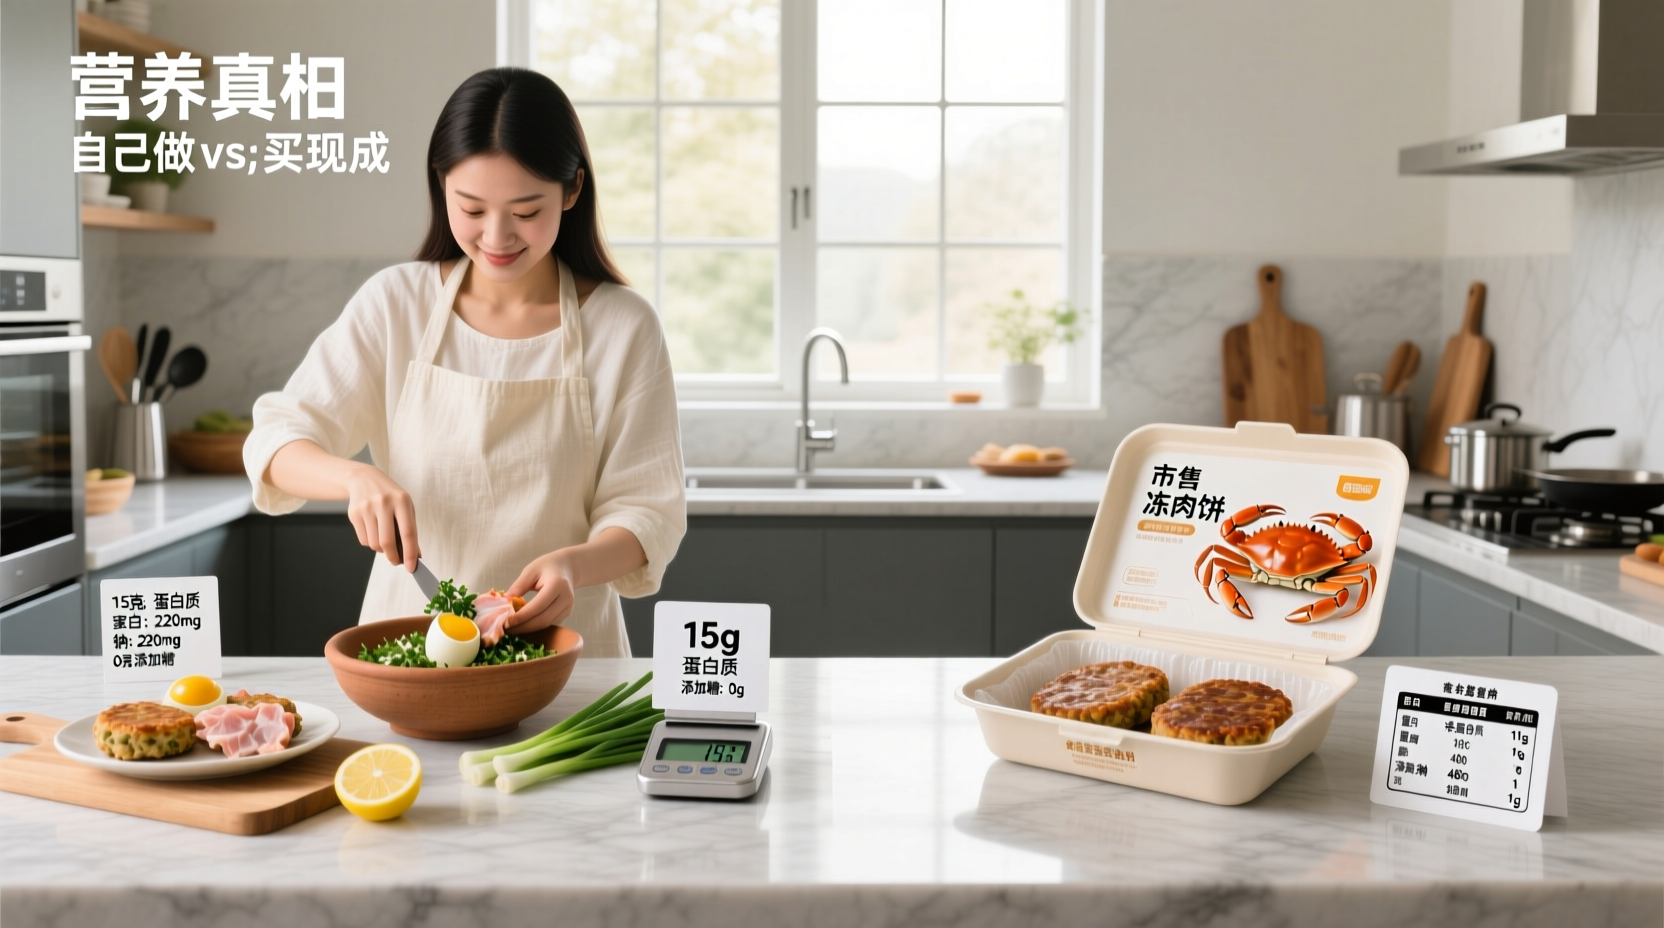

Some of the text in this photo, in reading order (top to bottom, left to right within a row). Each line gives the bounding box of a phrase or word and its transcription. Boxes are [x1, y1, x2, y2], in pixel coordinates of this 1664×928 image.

[1151, 463, 1203, 491] 市售
[1142, 491, 1226, 523] 冻肉饼
[153, 591, 200, 610] 蛋白质
[154, 614, 201, 630] 220mg
[137, 634, 181, 649] 220mg
[684, 621, 740, 656] 15g
[682, 656, 738, 676] 蛋白质
[728, 682, 745, 698] 0g
[1508, 793, 1521, 808] 1g
